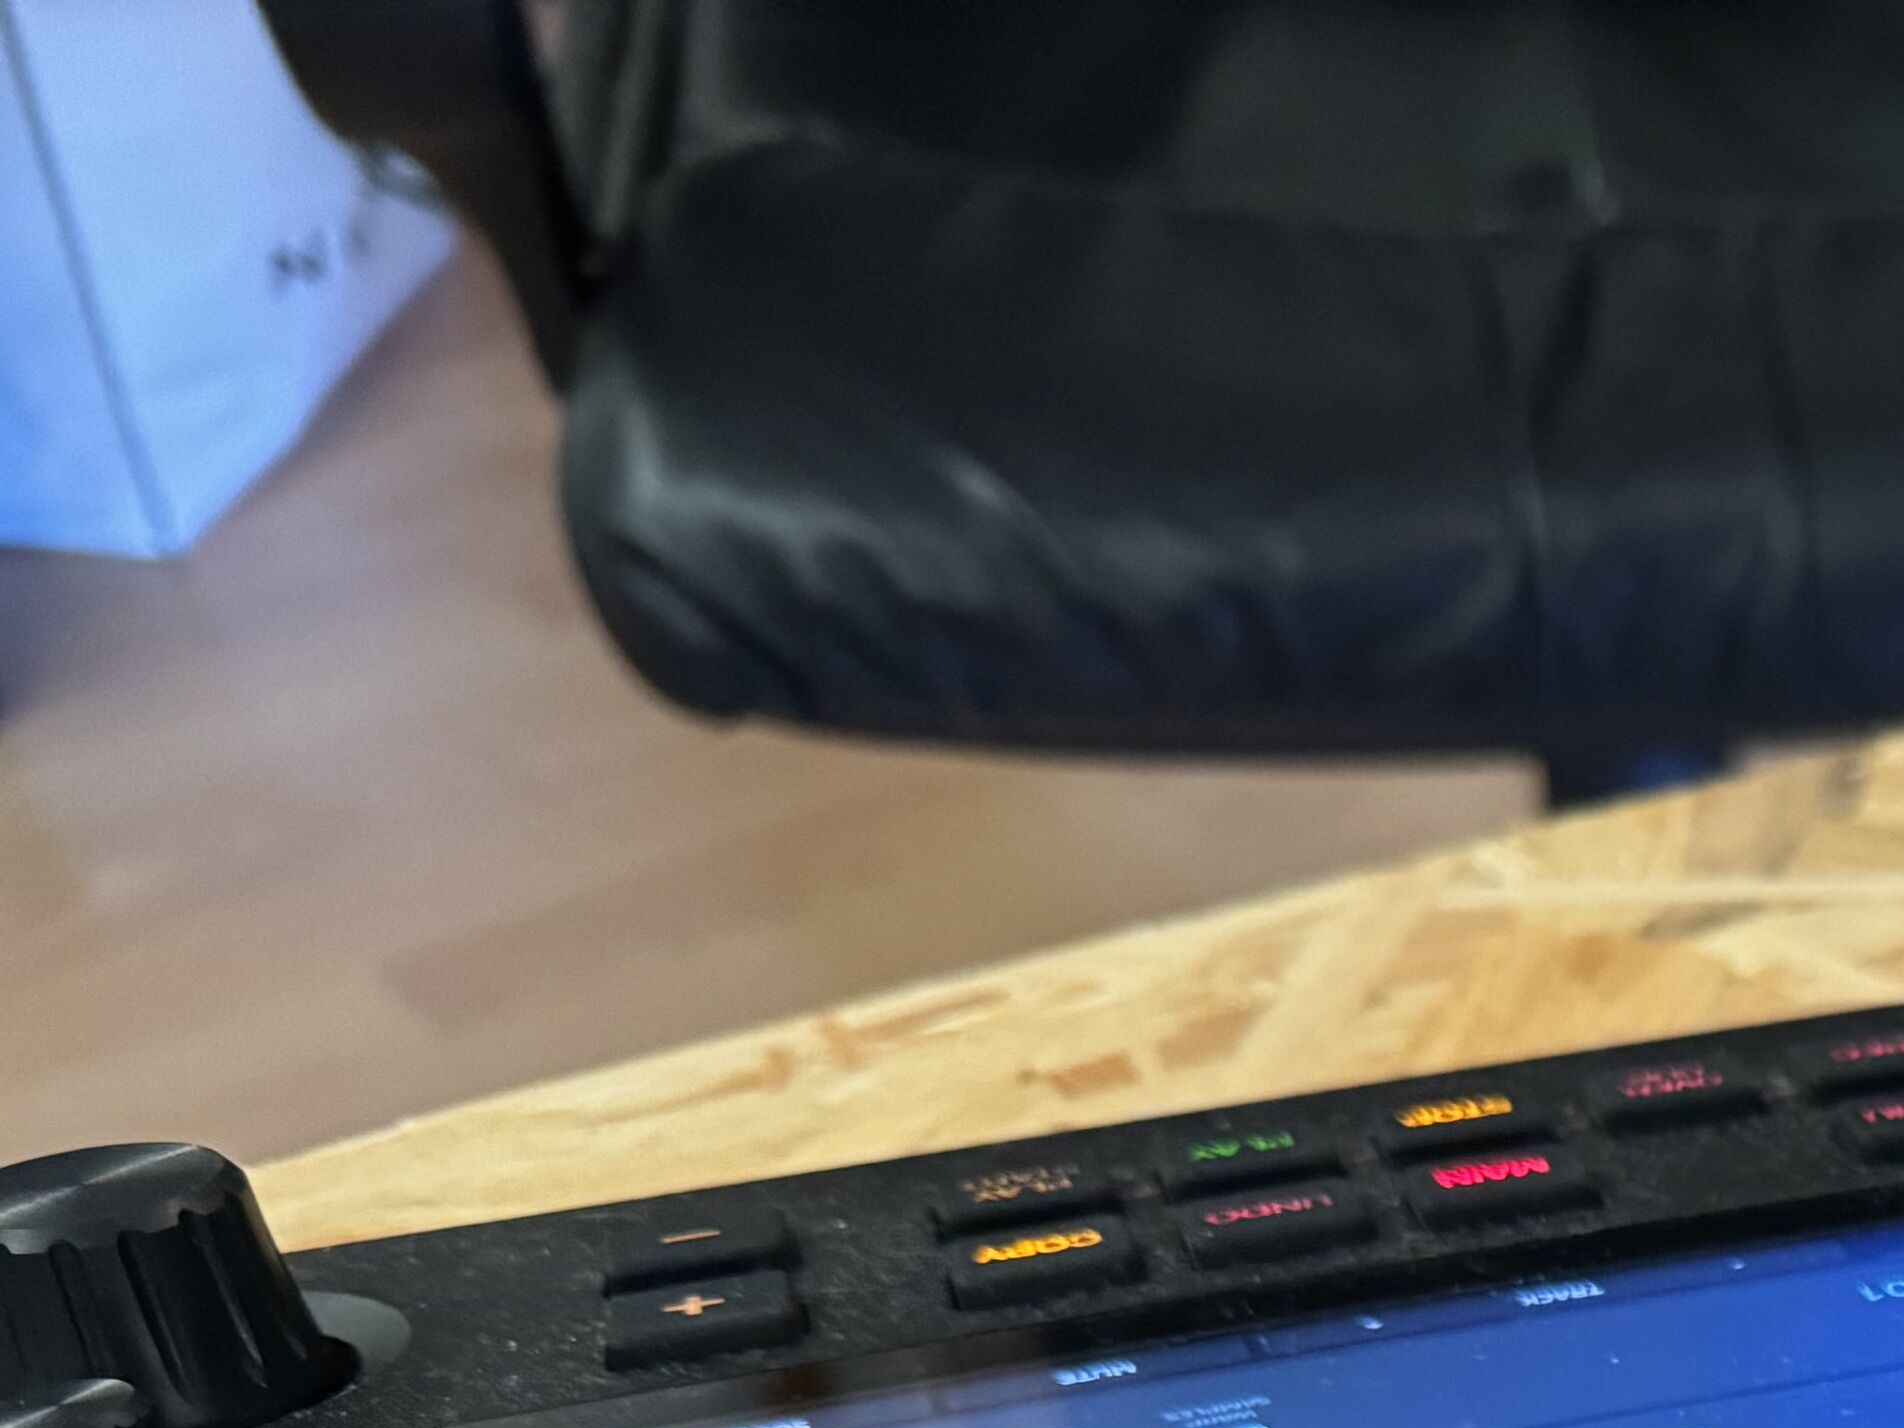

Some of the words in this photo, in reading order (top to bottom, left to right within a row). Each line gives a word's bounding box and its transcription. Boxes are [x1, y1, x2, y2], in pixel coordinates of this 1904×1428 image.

[1431, 1153, 1552, 1189] MAIN
[1204, 1193, 1333, 1226] UNDO
[973, 1228, 1103, 1264] COPY
[1516, 1280, 1605, 1308] TRACK
[1052, 1358, 1138, 1388] MUTE
